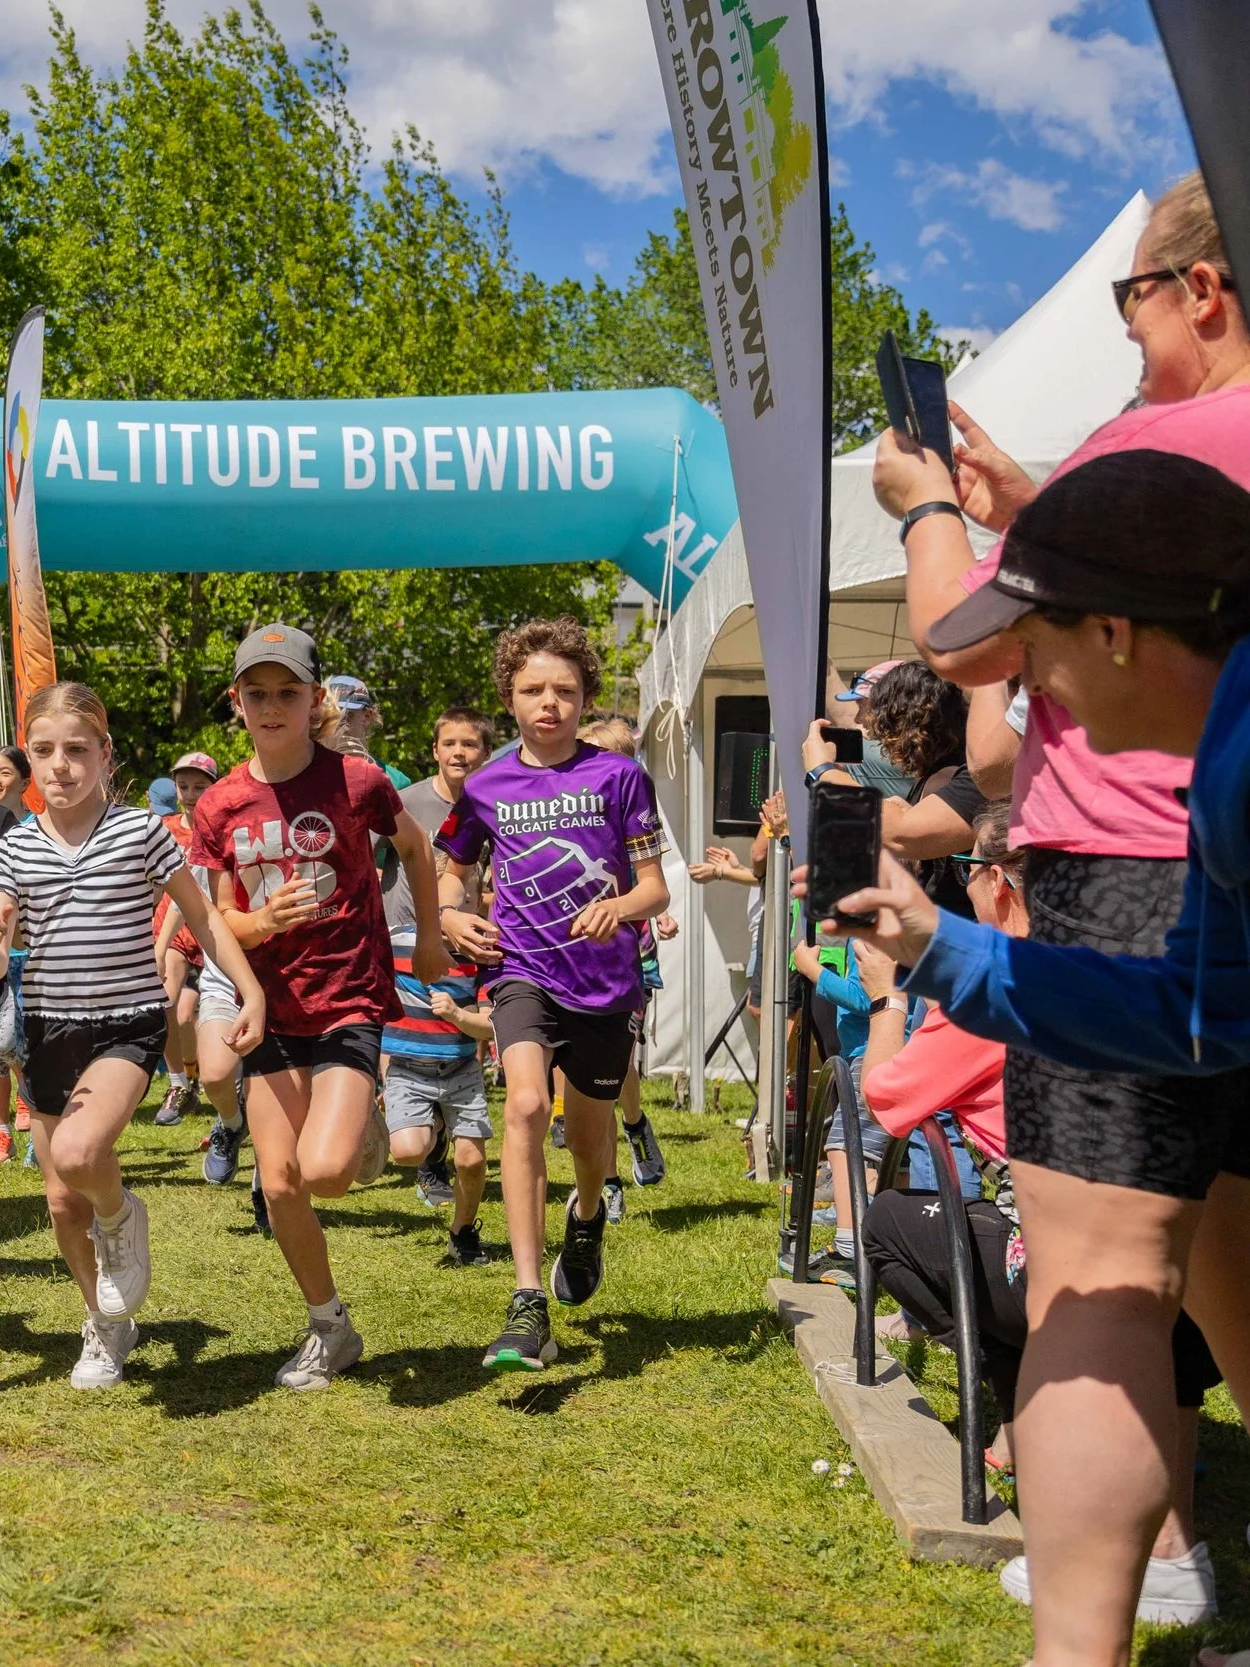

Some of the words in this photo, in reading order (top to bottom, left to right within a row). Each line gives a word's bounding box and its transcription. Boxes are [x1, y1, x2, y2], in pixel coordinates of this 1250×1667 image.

[672, 48, 703, 172] History
[696, 179, 720, 278] Meets
[714, 281, 738, 389] Nature
[45, 418, 320, 489] ALTITUDE
[341, 424, 615, 492] BREWING
[496, 788, 606, 823] dunedin
[499, 820, 557, 837] COLGATE
[560, 815, 606, 830] GAMES
[559, 900, 571, 911] 2
[593, 1078, 620, 1086] adidas
